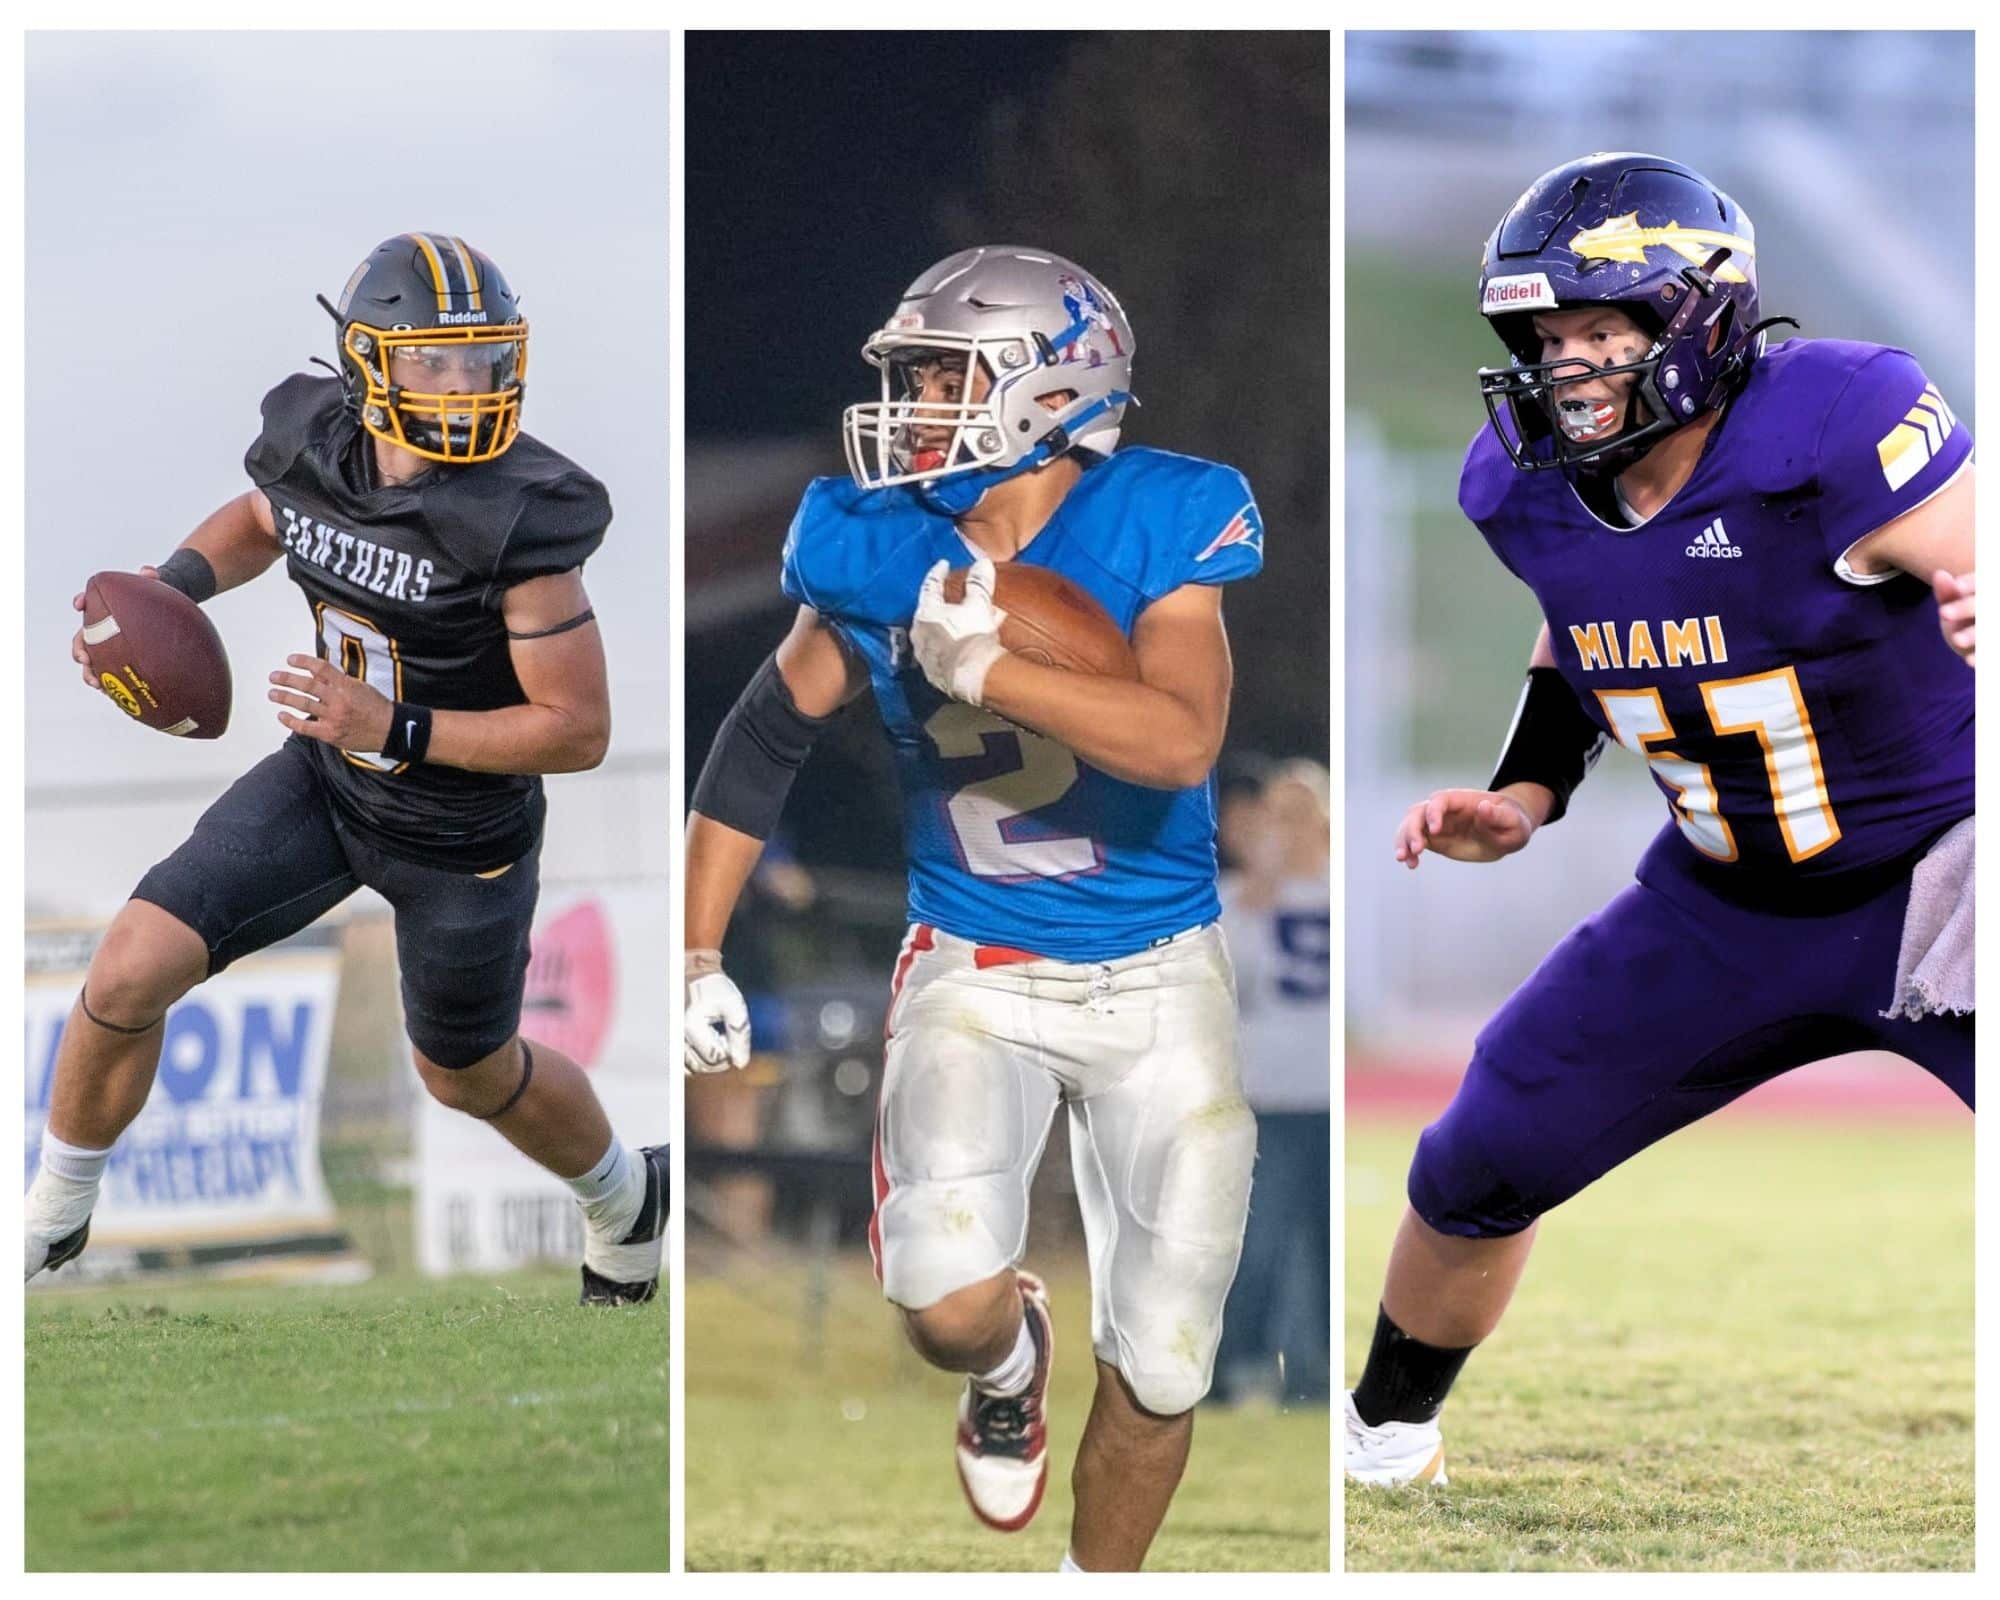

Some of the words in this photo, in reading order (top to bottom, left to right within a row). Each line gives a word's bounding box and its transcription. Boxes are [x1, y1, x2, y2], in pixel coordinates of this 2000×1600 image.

[1487, 281, 1541, 302] Riddell
[438, 311, 487, 325] Riddell
[283, 507, 434, 602] PANTHERS
[1685, 542, 1743, 559] adidas
[1568, 615, 1728, 671] MIAMI
[923, 701, 1104, 884] 2
